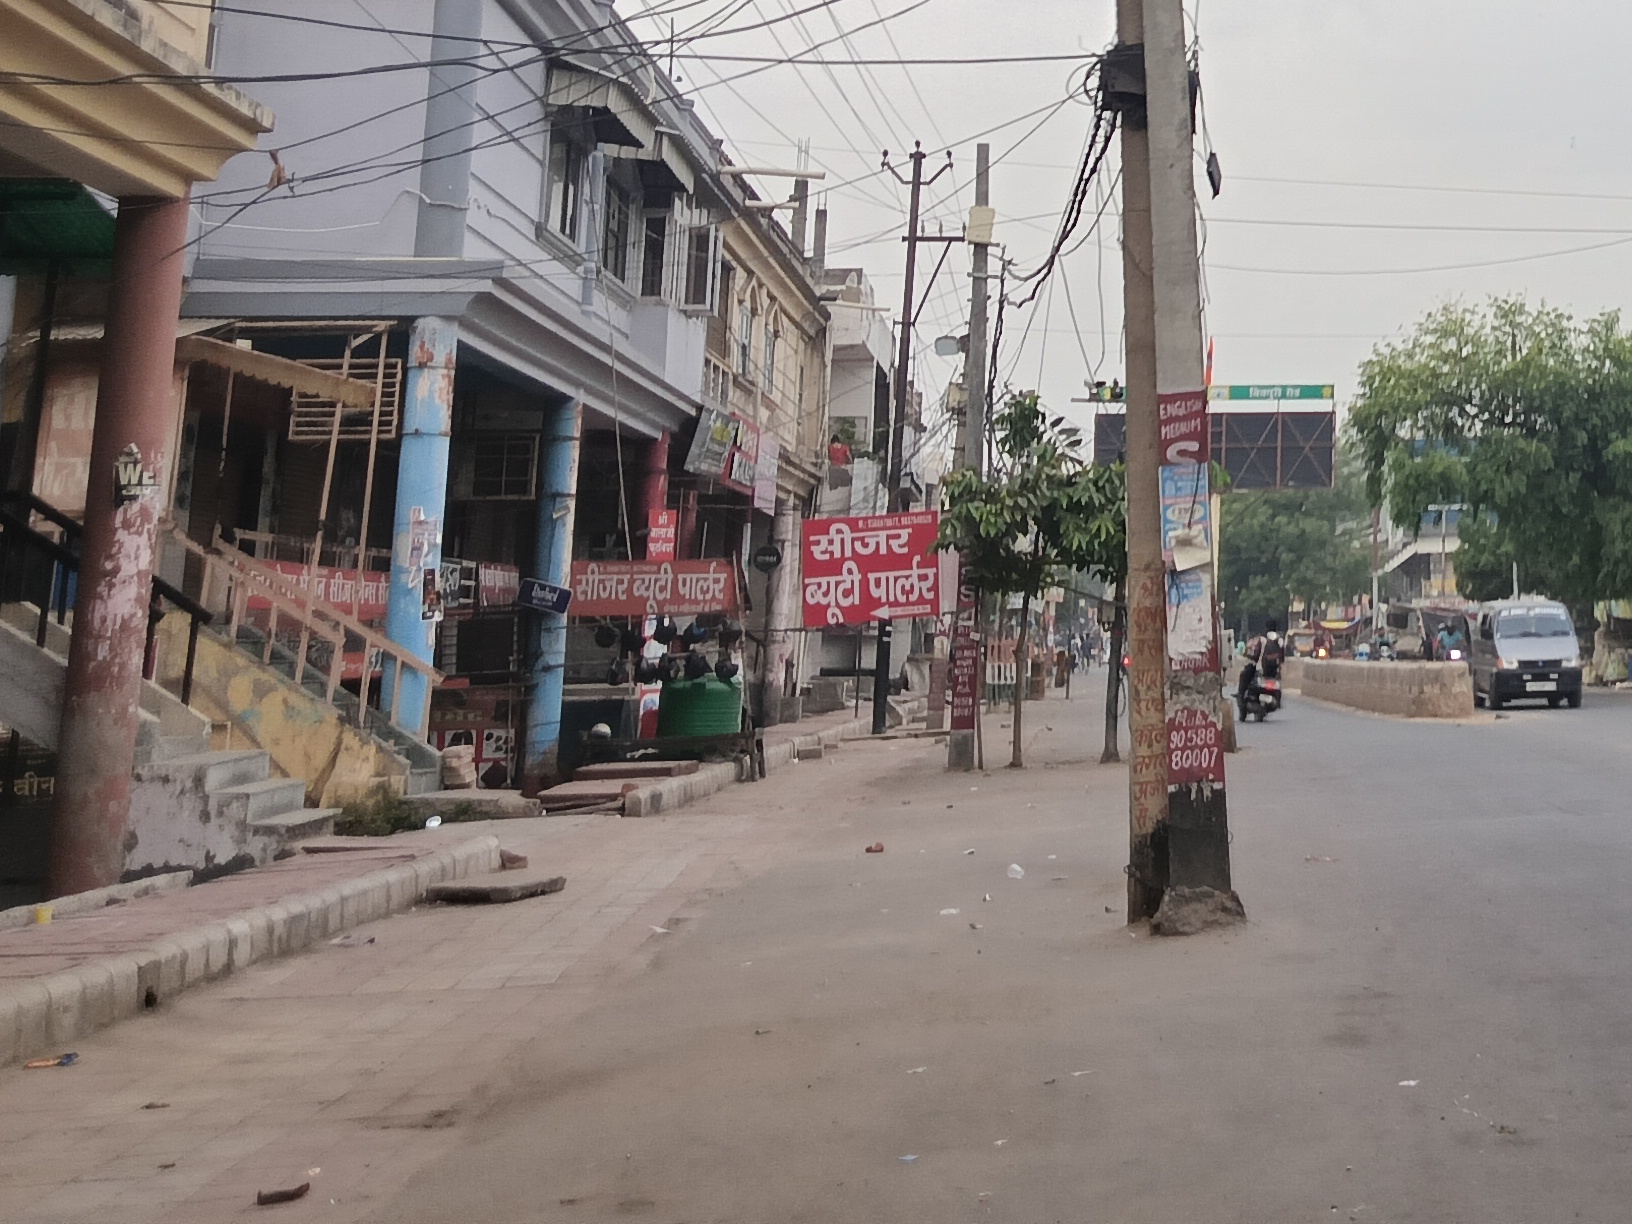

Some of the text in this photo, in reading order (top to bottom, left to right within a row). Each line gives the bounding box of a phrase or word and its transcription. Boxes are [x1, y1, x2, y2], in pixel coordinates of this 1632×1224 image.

[1161, 417, 1201, 440] MEDIUM
[809, 523, 913, 560] सीजर
[576, 563, 630, 601] सीजर
[632, 562, 674, 613] ब्यूटी
[678, 561, 727, 600] पार्लर
[804, 555, 937, 624] ब्यूटी पार्लर
[1170, 727, 1216, 749] 90588
[1171, 747, 1219, 771] 80007
